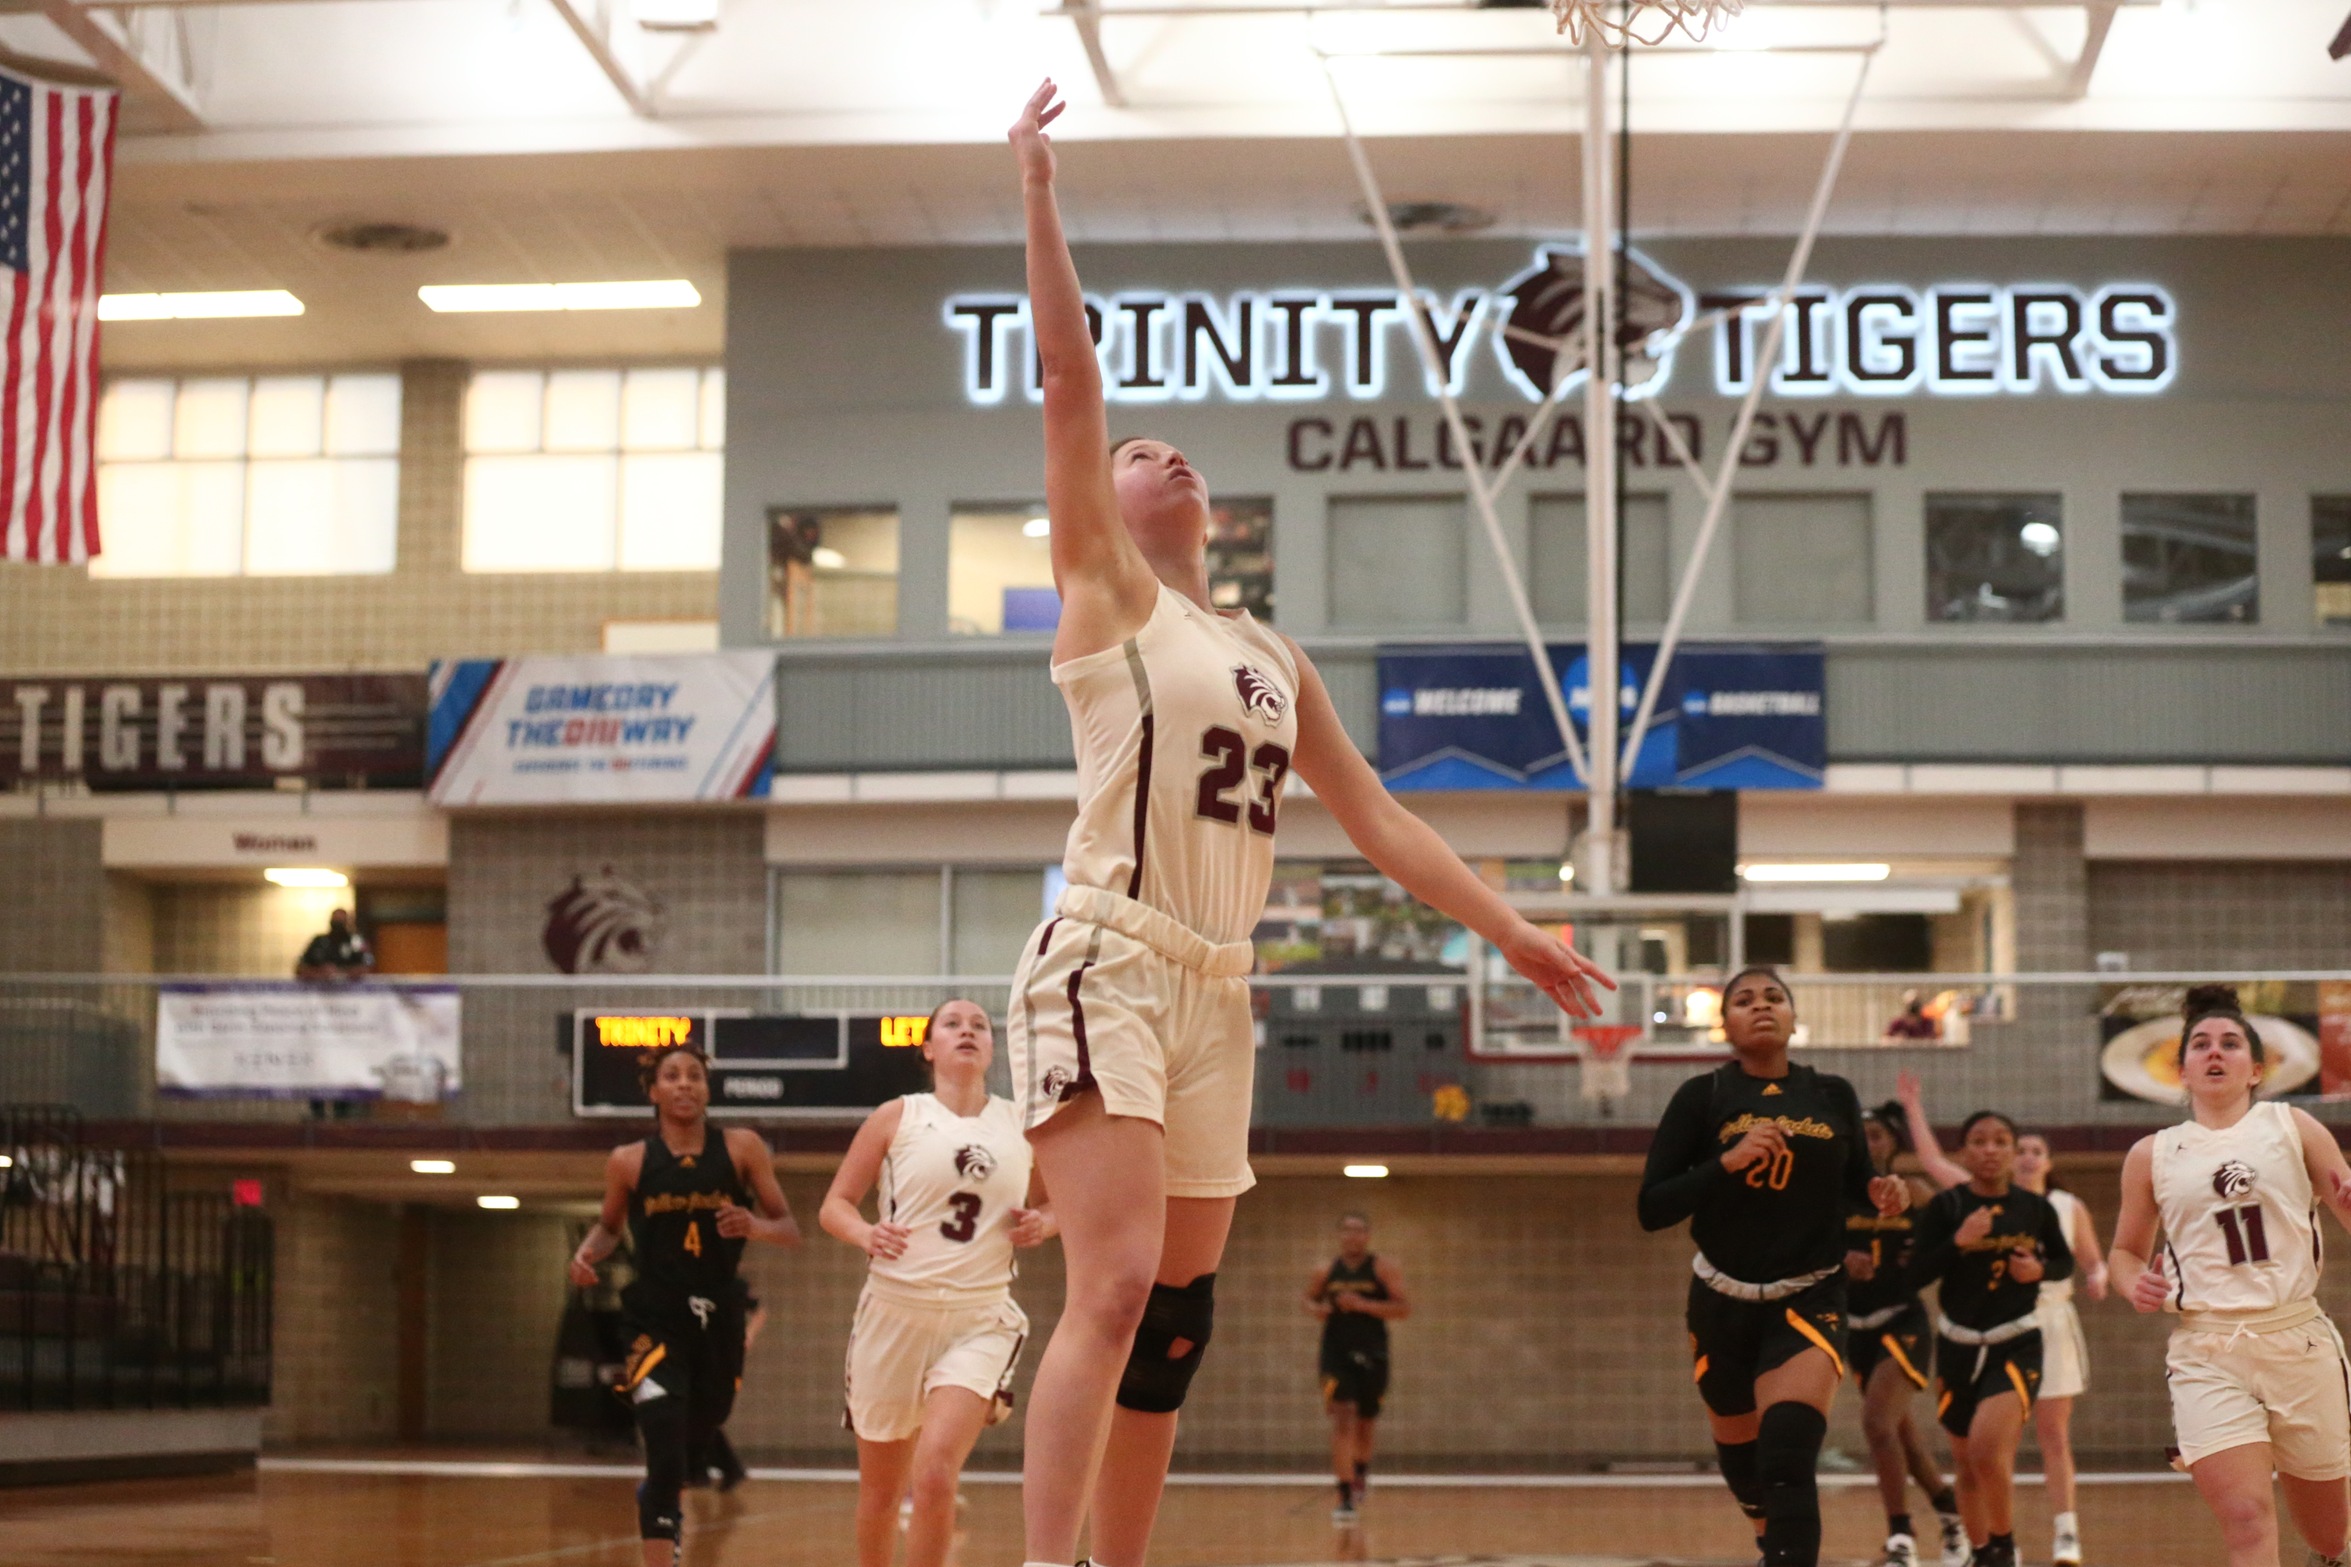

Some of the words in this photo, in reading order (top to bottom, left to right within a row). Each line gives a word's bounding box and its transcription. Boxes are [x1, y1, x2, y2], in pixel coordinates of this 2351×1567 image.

[1701, 290, 2172, 382] TIGERS
[1735, 412, 1908, 468] GYM
[14, 684, 305, 772] TIGERS
[1195, 724, 1289, 838] 23
[595, 1016, 691, 1047] TRINITY
[1745, 1149, 1795, 1191] 20
[683, 1221, 702, 1258] 4
[940, 1191, 982, 1244] 3
[2214, 1203, 2271, 1268] 11
